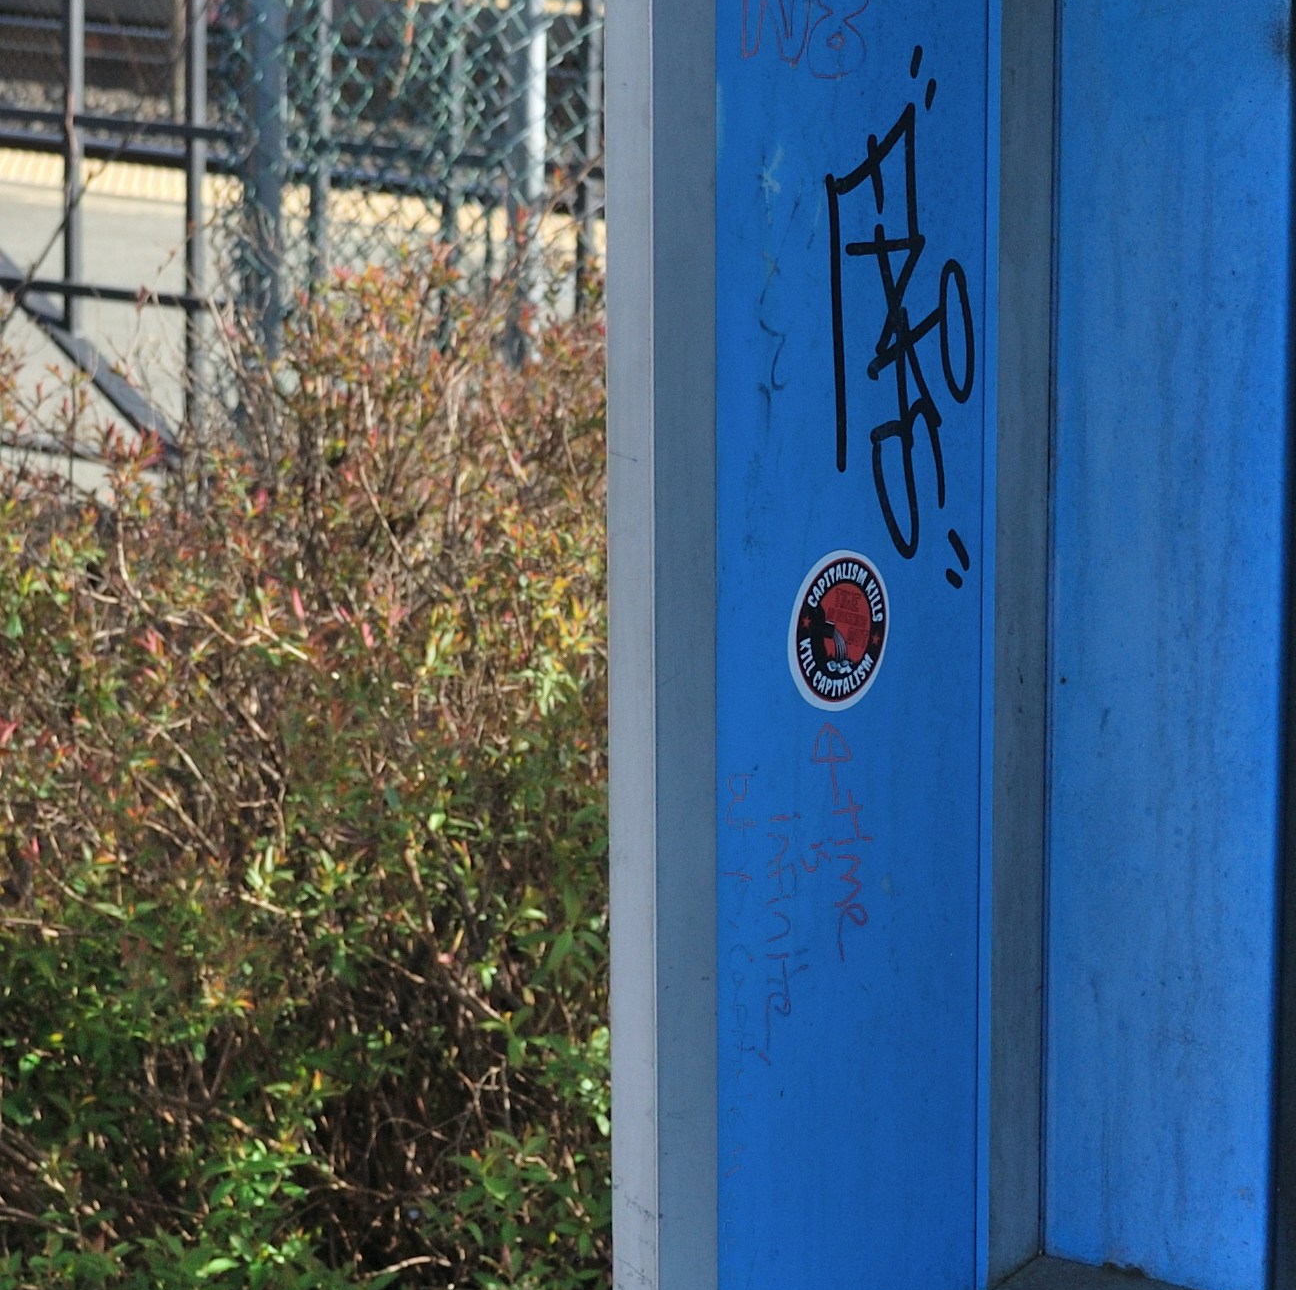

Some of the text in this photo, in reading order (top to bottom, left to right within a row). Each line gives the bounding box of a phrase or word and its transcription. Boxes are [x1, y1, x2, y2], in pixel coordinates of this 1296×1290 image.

[807, 562, 869, 609] CAPITALISM
[865, 577, 884, 623] KILLS
[799, 637, 874, 697] KILL CAPITALISM
